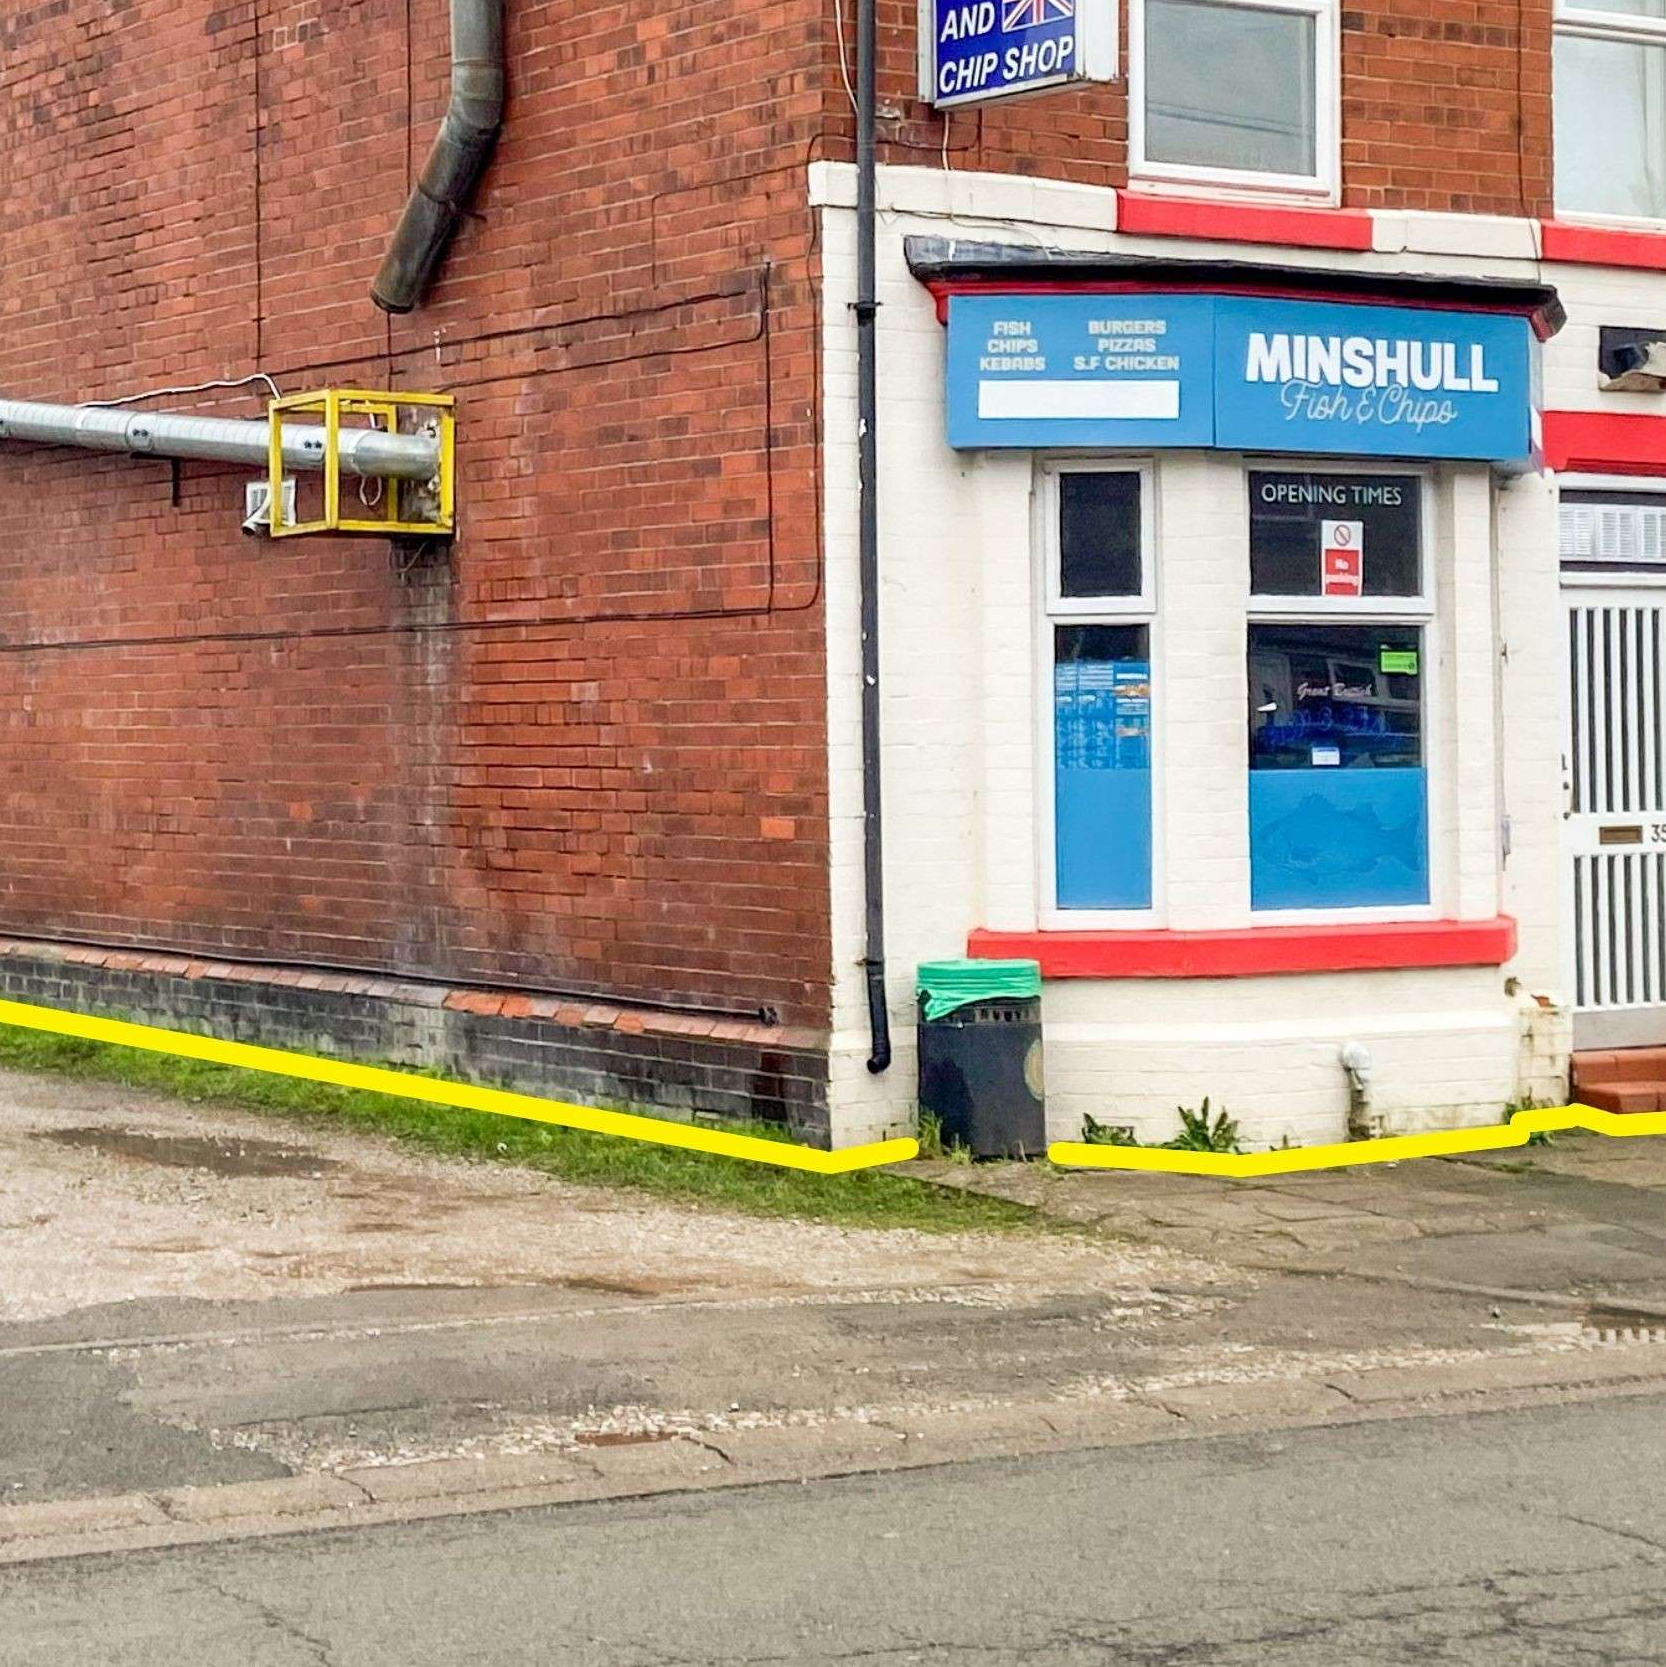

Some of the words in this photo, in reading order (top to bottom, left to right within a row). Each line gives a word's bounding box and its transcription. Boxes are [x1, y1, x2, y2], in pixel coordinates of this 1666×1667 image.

[940, 1, 995, 43] AND
[939, 52, 999, 93] CHIP
[1003, 35, 1074, 80] SHOP
[993, 321, 1032, 336] FISH
[1088, 320, 1167, 335] BURGERS
[987, 338, 1038, 354] CHIPS
[1098, 338, 1157, 353] PIZZAS
[979, 356, 1046, 371] KEBABS
[1105, 356, 1180, 371] CHICKEN
[1245, 332, 1499, 393] MINSHULL
[1280, 379, 1355, 421] Fish
[1355, 386, 1377, 424] &
[1378, 384, 1458, 433] Chips
[1261, 484, 1347, 504] OPENING
[1351, 485, 1402, 505] TIMES
